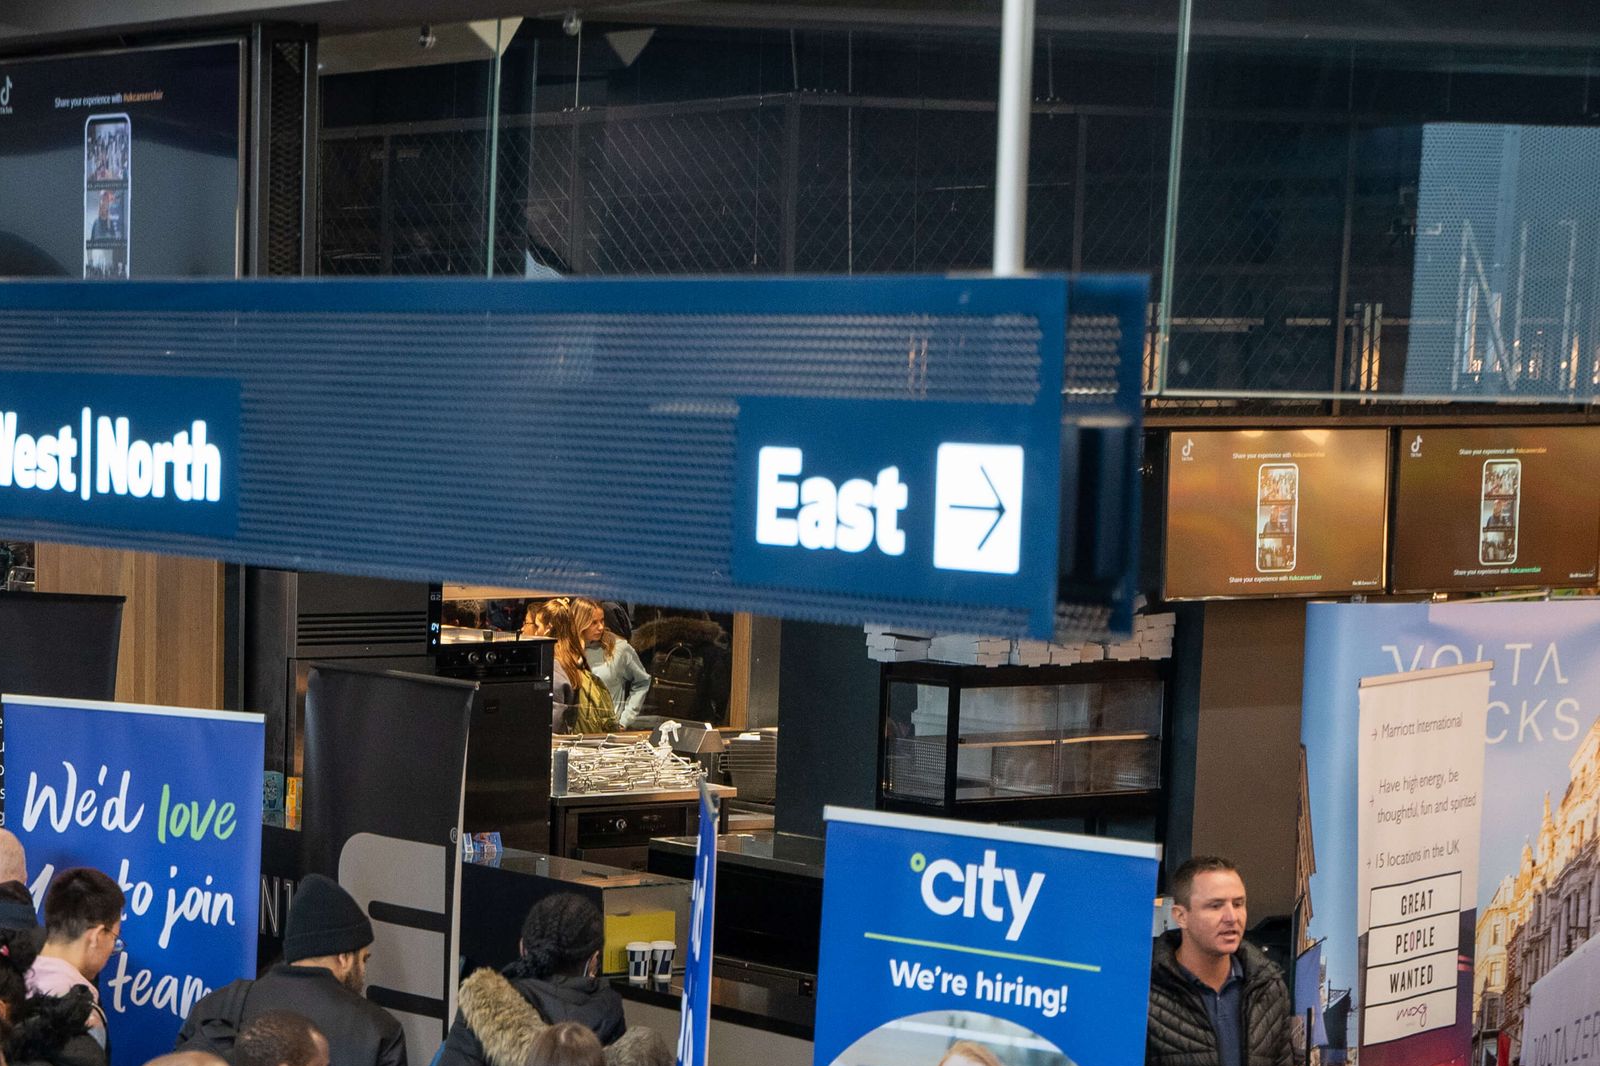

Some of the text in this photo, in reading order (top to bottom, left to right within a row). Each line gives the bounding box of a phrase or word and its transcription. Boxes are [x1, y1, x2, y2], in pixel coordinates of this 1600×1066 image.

[54, 97, 70, 108] Share
[70, 98, 82, 109] your
[82, 95, 111, 107] experience
[111, 93, 123, 104] with
[96, 414, 223, 503] North
[1247, 453, 1258, 461] your
[1258, 452, 1281, 460] experience
[755, 445, 909, 557] East
[1254, 576, 1279, 584] experience
[1381, 713, 1463, 739] Marriott International
[1379, 768, 1459, 795] Have high energy, be
[21, 760, 237, 844] We'd love
[1420, 800, 1433, 817] fun
[1434, 796, 1448, 813] and
[1450, 792, 1477, 814] spirited
[1375, 838, 1460, 869] 15 locations in the UK
[120, 858, 154, 922] to
[158, 864, 236, 949] join
[1400, 888, 1434, 916] GREAT
[1396, 926, 1435, 955] PEOPLE
[889, 959, 1068, 1018] We're hiring!
[1389, 964, 1434, 994] WANTED
